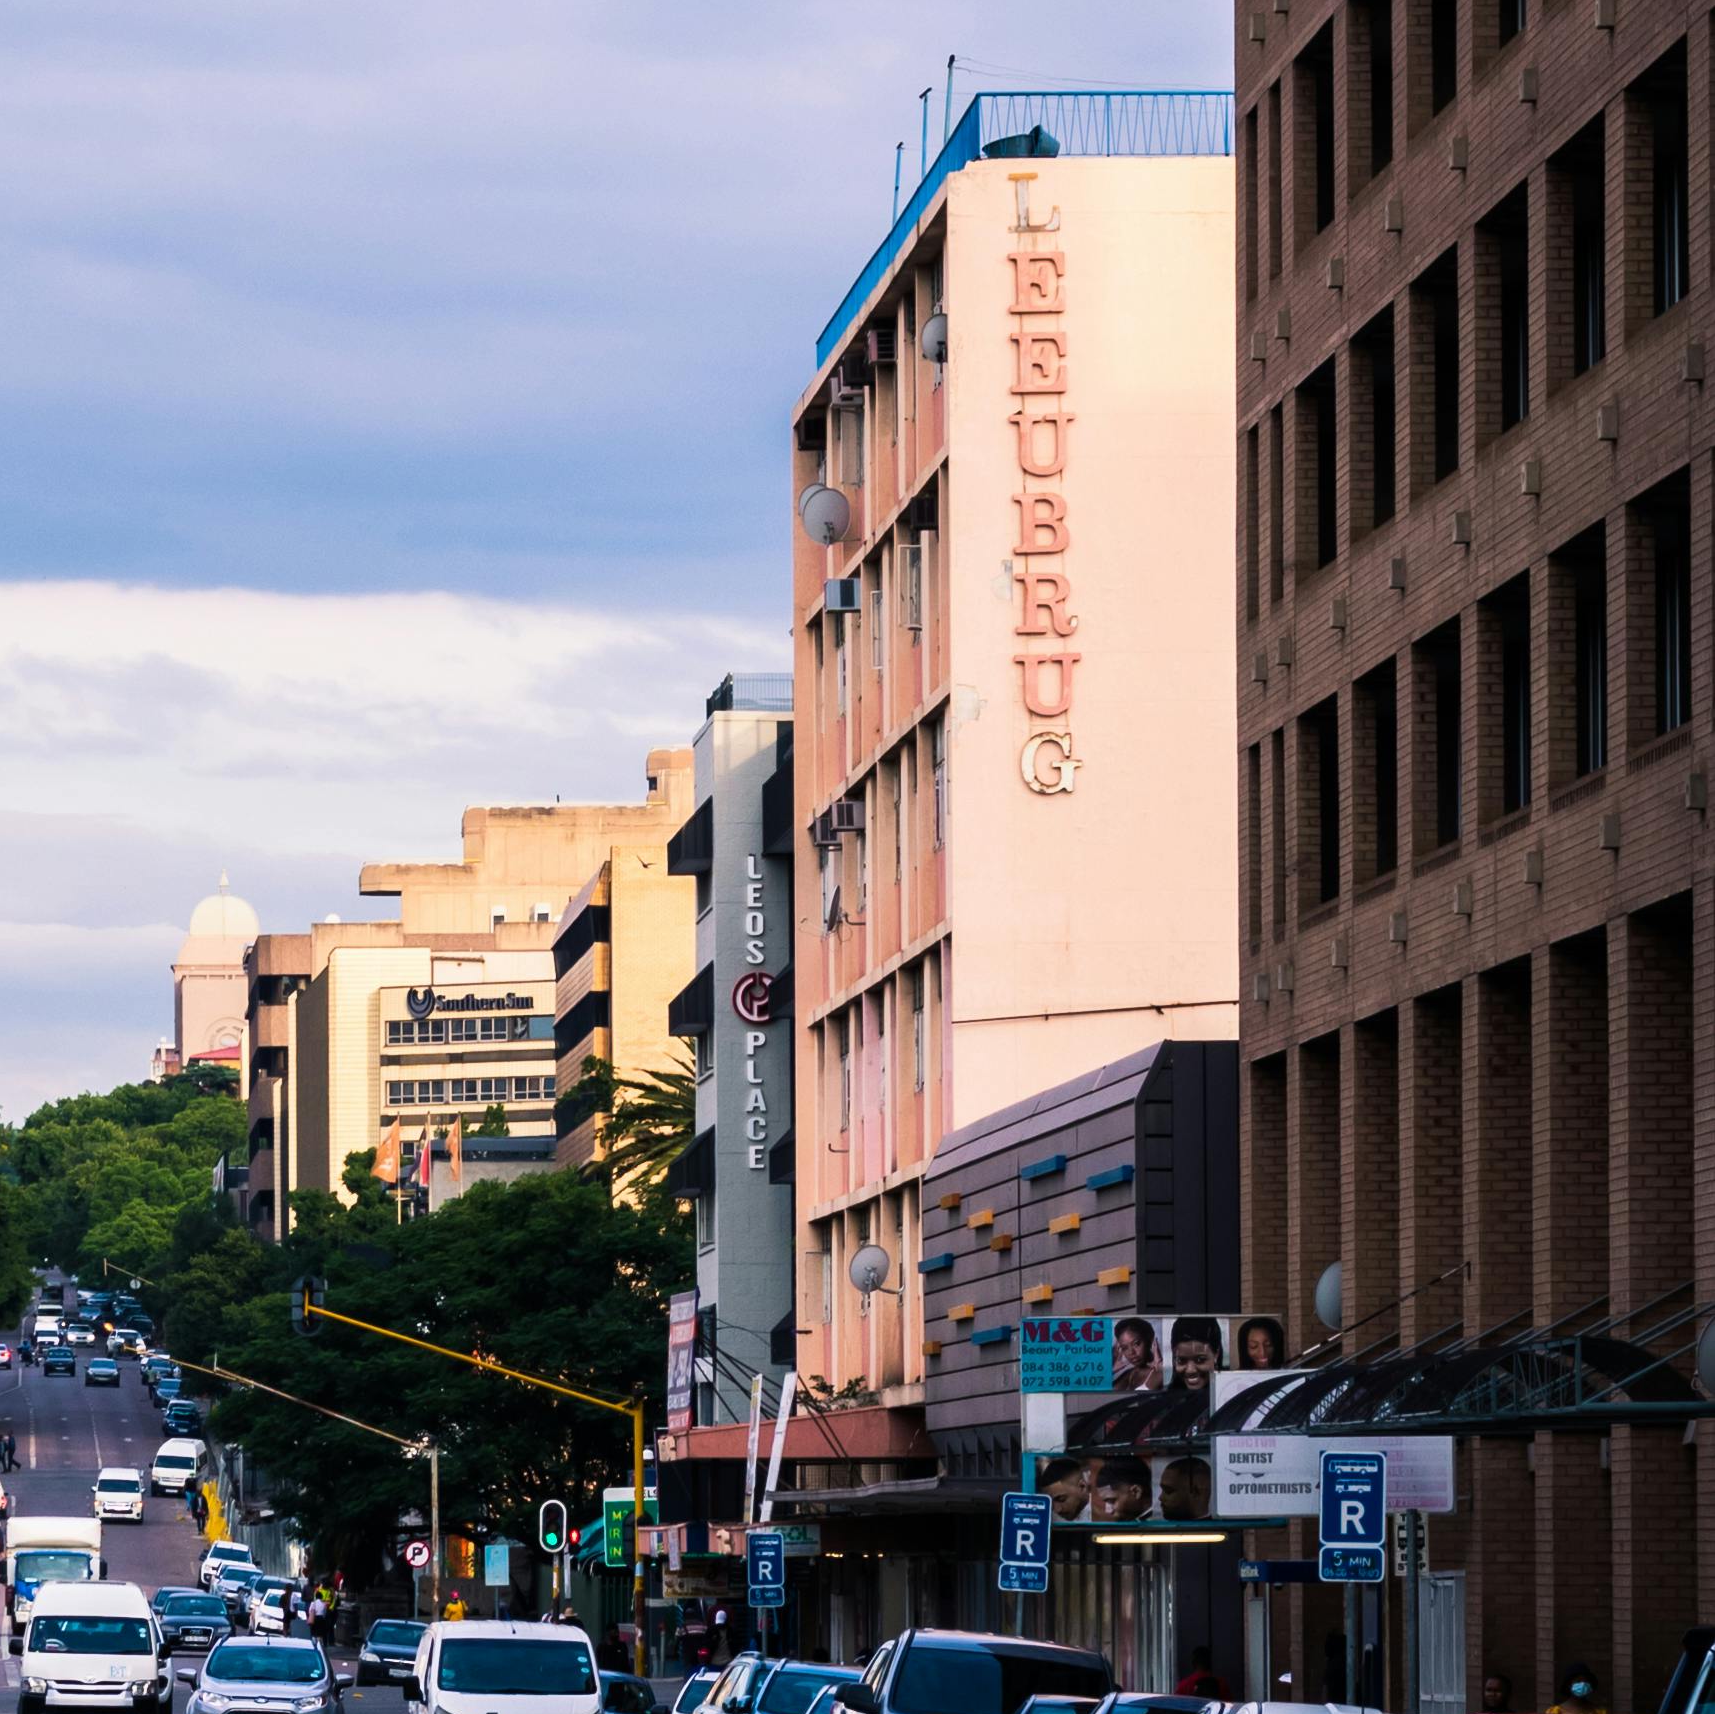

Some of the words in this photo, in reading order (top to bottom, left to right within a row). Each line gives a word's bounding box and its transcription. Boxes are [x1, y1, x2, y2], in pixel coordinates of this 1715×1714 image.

[1006, 172, 1084, 796] LEEUBRUG
[744, 853, 766, 966] LEOS
[745, 1030, 768, 1171] PLACE
[1022, 1320, 1105, 1343] M&G
[1022, 1345, 1061, 1356] Beauty
[1065, 1345, 1104, 1354] Parlour
[1022, 1362, 1045, 1373] 084
[1049, 1362, 1070, 1373] 386
[1229, 1452, 1273, 1464] DENTIST
[1229, 1483, 1312, 1495] OPTOMETRISTS
[1340, 1500, 1366, 1535] R
[1015, 1529, 1036, 1557] R
[1333, 1551, 1343, 1567] 5
[1349, 1556, 1372, 1567] MIN
[758, 1561, 773, 1581] R
[1009, 1567, 1017, 1580] 5
[1021, 1571, 1038, 1580] MIN
